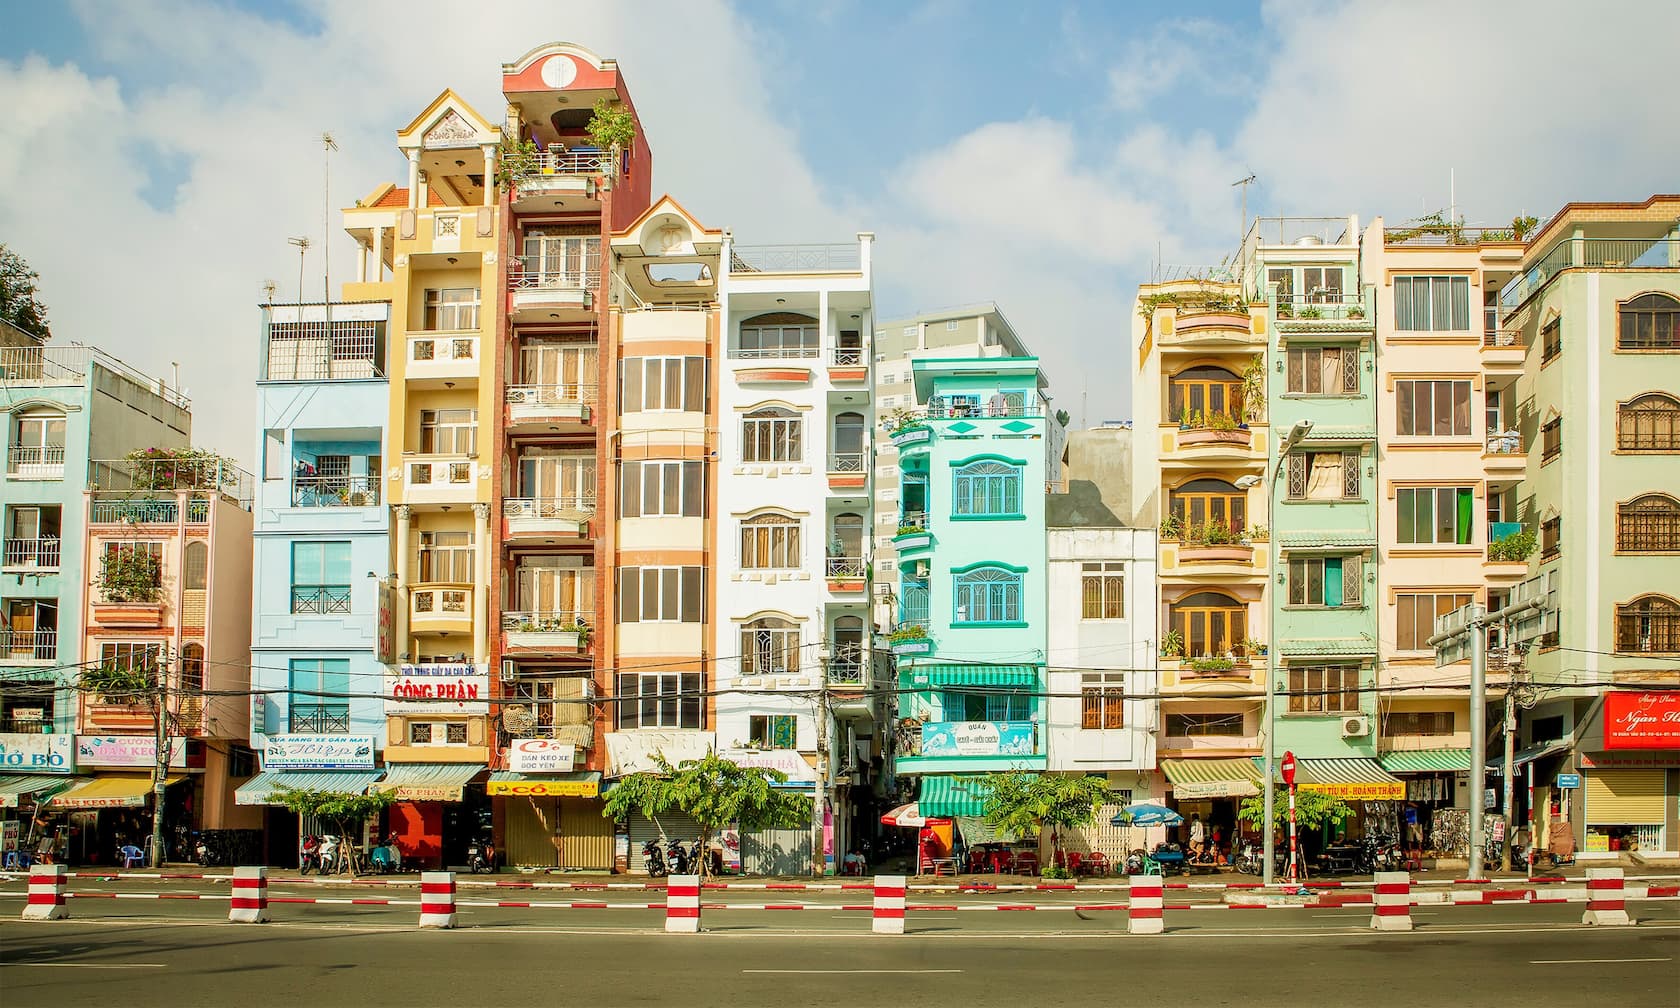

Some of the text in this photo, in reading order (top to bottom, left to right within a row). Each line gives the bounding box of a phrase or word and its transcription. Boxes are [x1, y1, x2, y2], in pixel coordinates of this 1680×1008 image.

[393, 678, 478, 707] CÔNG PHẬN
[1616, 710, 1657, 732] Ngàn
[32, 751, 64, 767] BÒ
